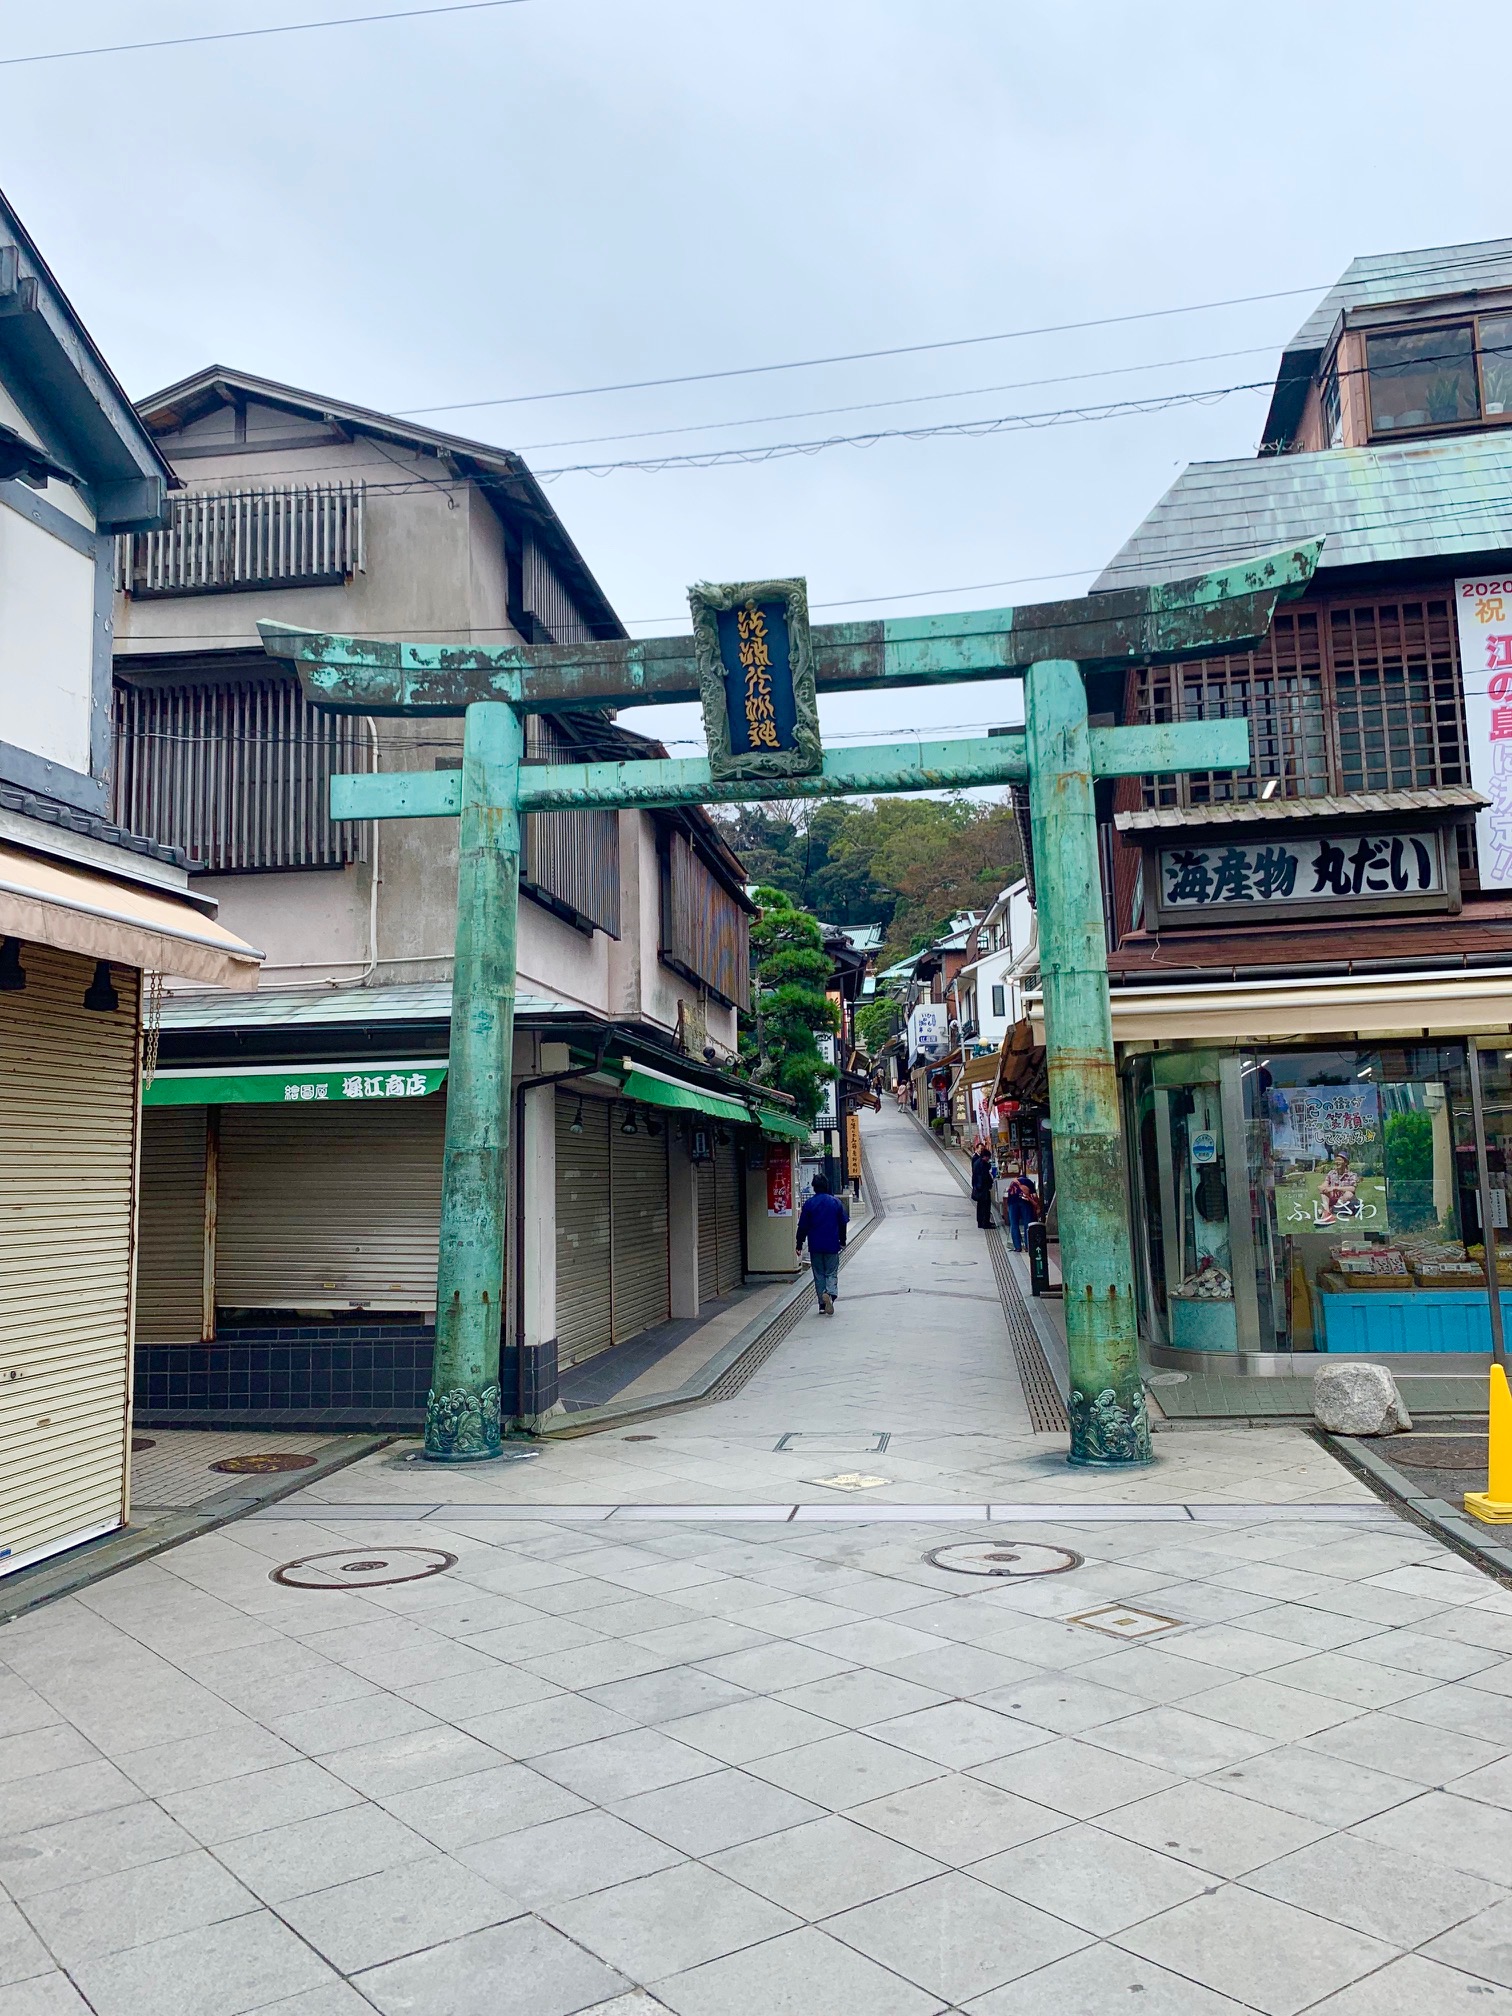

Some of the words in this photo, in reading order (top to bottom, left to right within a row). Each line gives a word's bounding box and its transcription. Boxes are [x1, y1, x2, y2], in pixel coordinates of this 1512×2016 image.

[1462, 580, 1512, 598] 2020
[1475, 597, 1506, 624] 祝
[1165, 845, 1299, 904] 海産物
[1310, 836, 1432, 895] 丸だい
[342, 1073, 427, 1098] 堀江商店
[1287, 1198, 1377, 1222] ふじさわ
